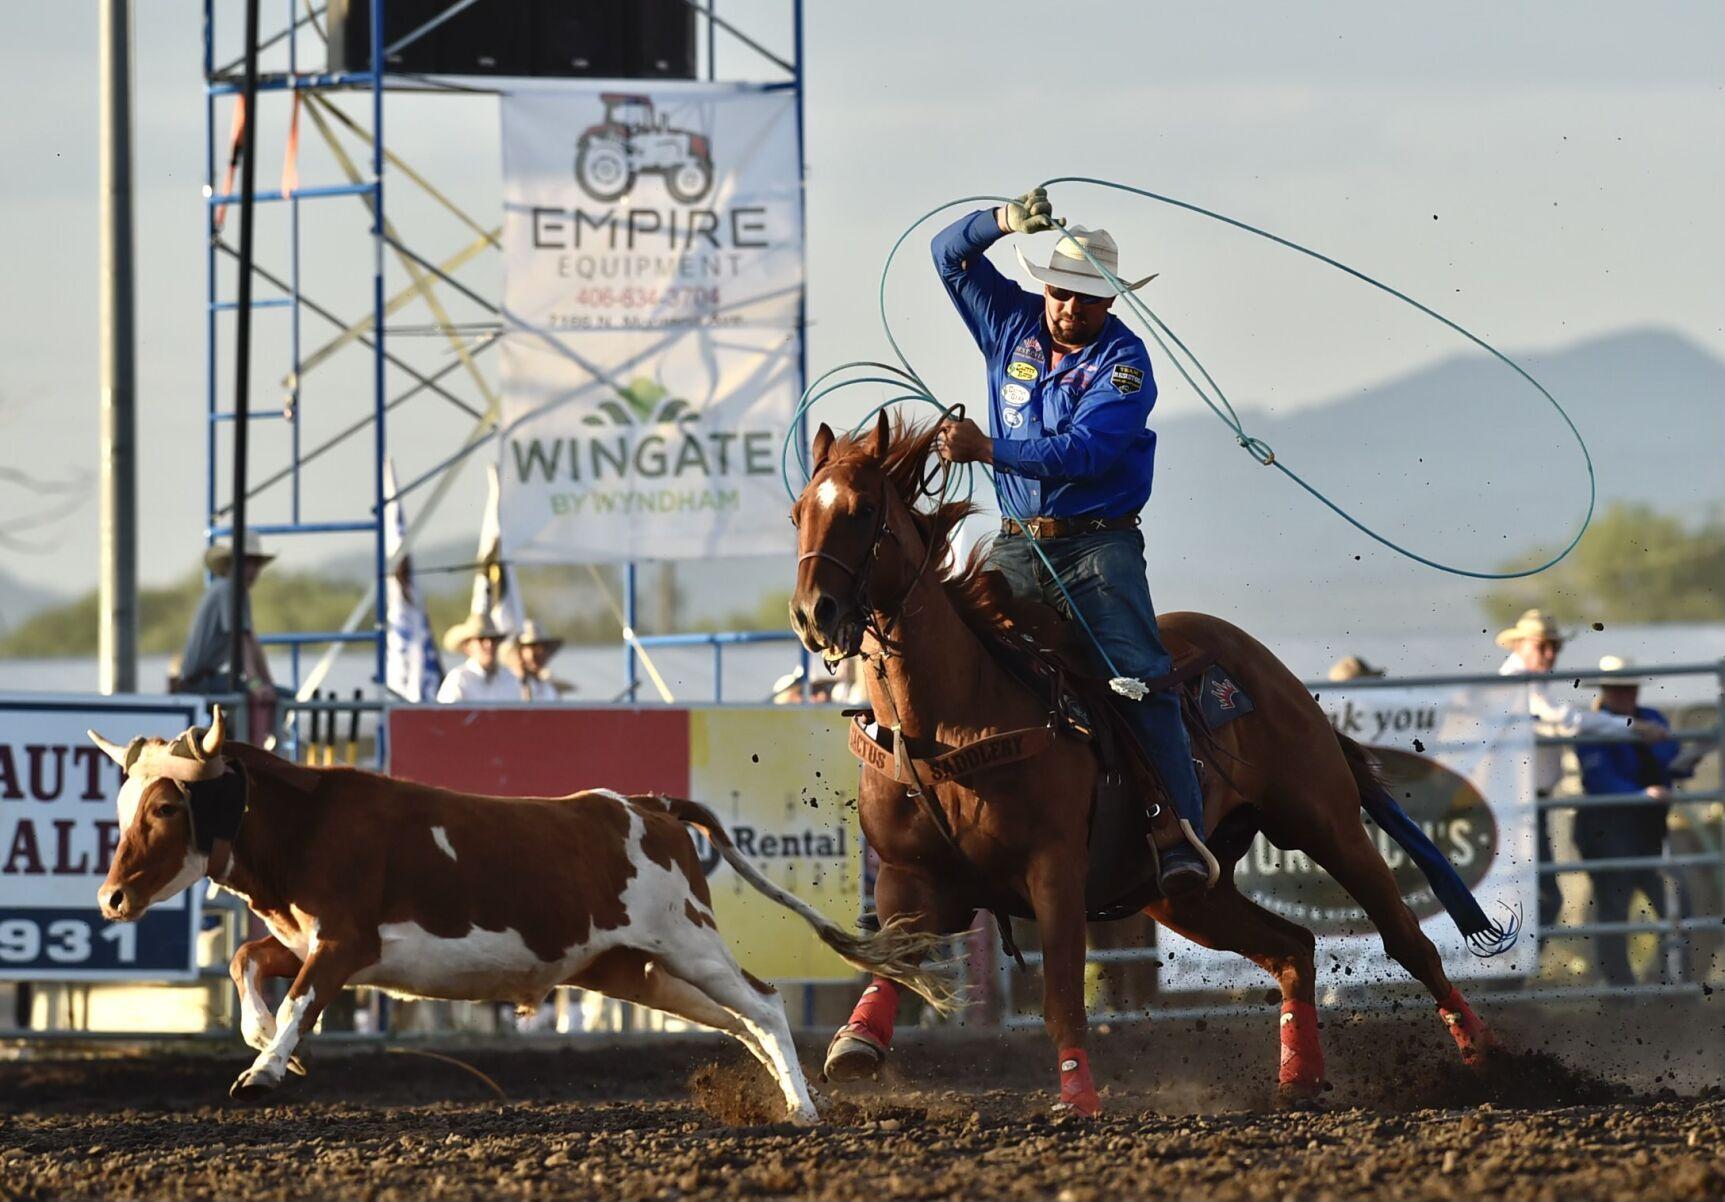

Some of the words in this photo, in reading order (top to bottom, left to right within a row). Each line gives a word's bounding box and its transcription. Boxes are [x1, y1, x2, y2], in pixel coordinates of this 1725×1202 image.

[532, 207, 769, 249] EMPIRE
[557, 255, 743, 278] EQUIPMENT
[511, 431, 776, 484] WINGATE
[550, 491, 582, 516] BY
[590, 489, 740, 514] WYNDHAM
[1371, 707, 1437, 742] you
[0, 743, 129, 802] AUT
[732, 826, 847, 858] Rental
[0, 918, 138, 963] 931
